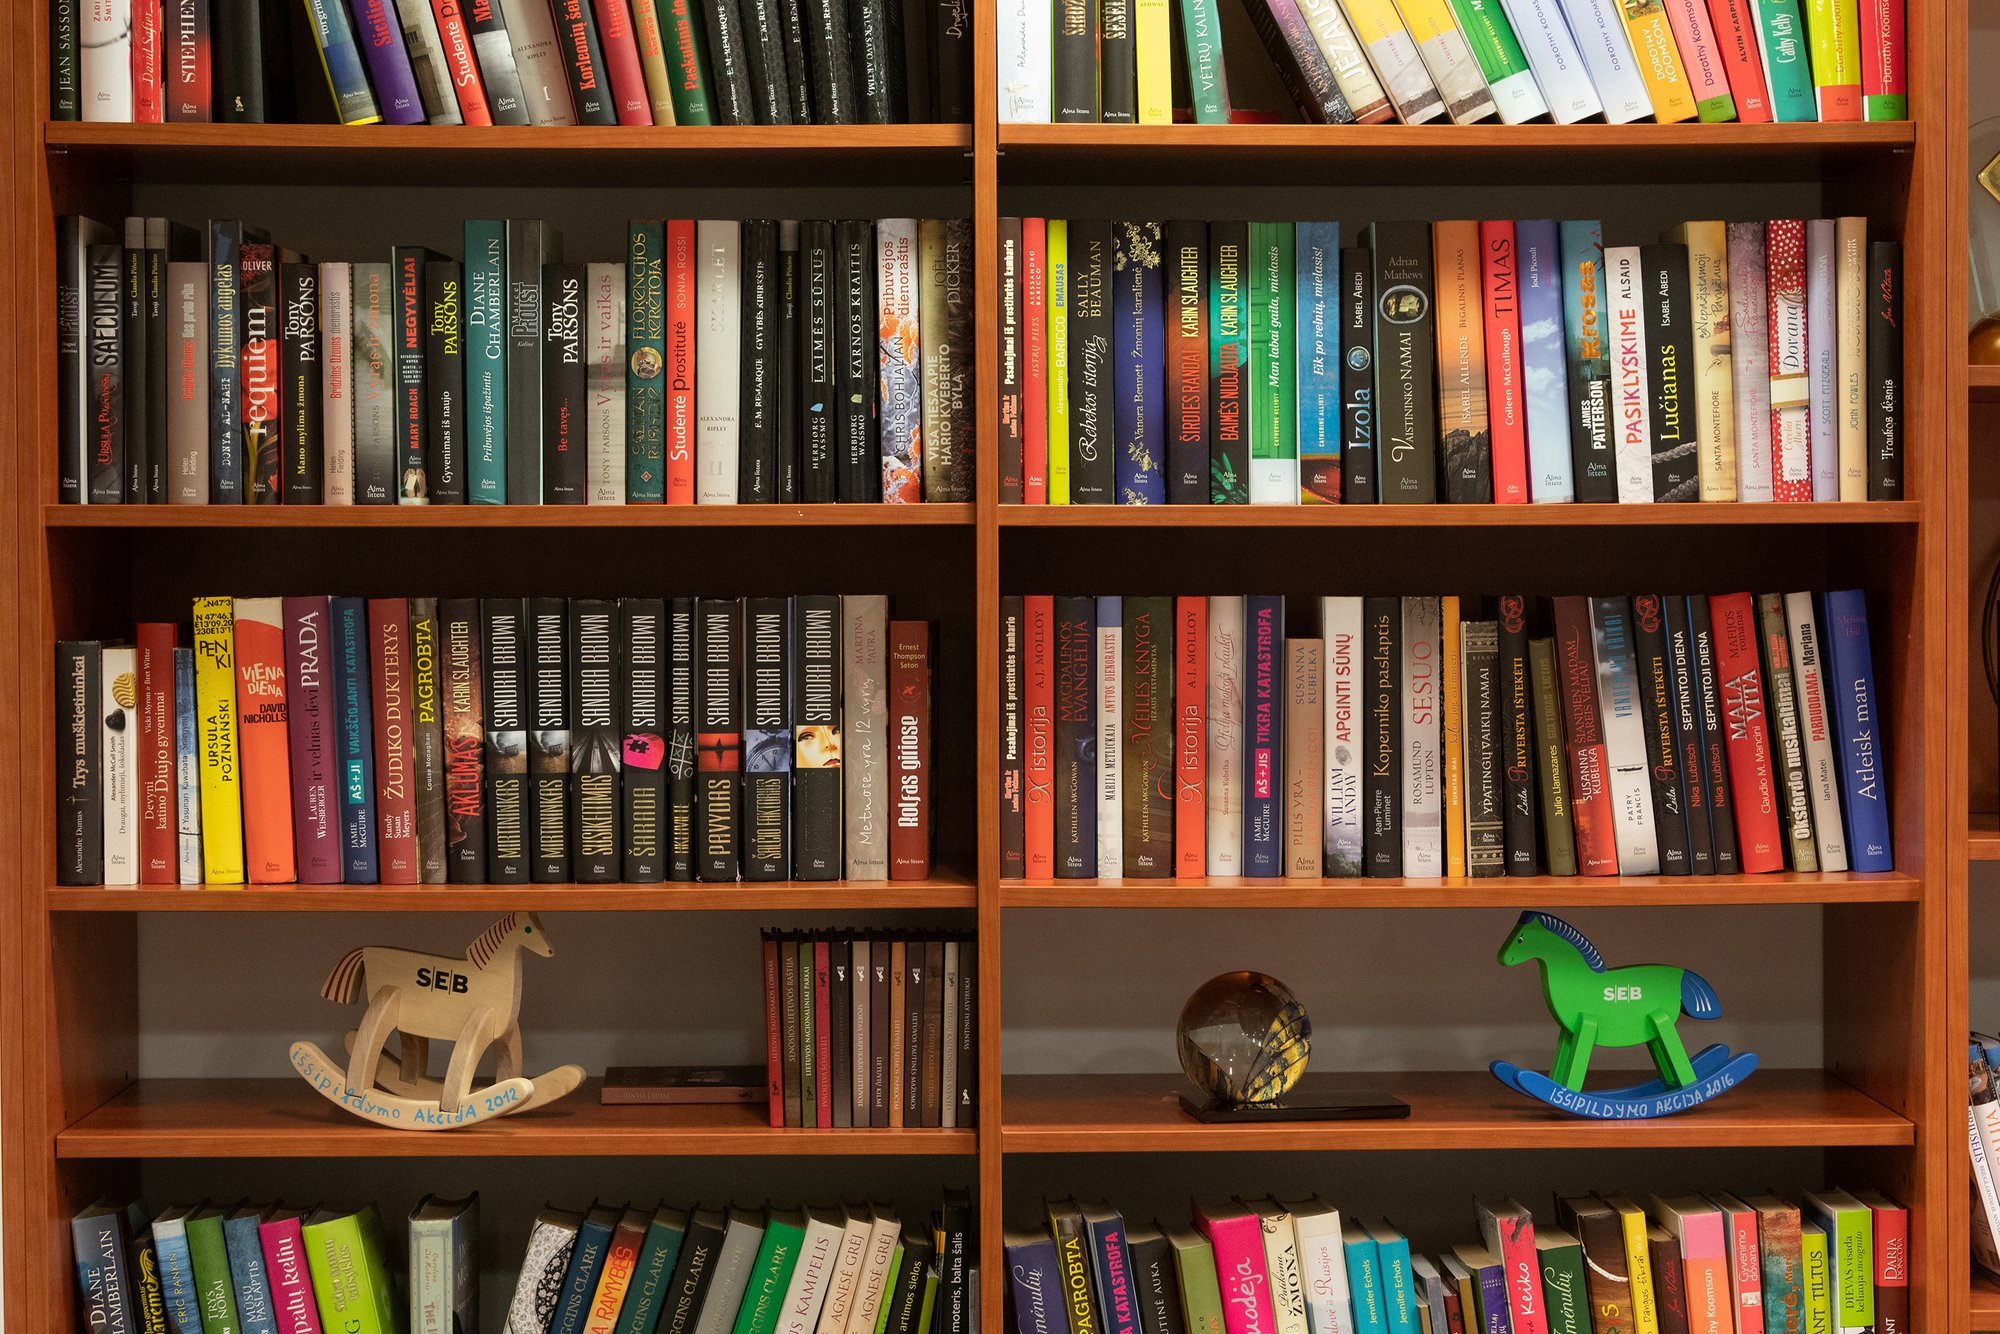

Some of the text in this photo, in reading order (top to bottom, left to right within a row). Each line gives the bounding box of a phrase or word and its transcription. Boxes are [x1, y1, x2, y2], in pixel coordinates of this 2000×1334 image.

[449, 20, 476, 87] Studentė
[517, 40, 552, 52] ALEXANDRA
[527, 51, 547, 60] RIPLEY
[571, 16, 595, 91] Korleonių
[717, 5, 730, 54] REMARQUE
[1545, 26, 1567, 71] DOROTHY
[1642, 28, 1664, 81] DOROTHY
[1652, 19, 1678, 83] KOOMSON
[1737, 35, 1747, 62] ALVIN
[1773, 13, 1797, 63] Cathy Kelly
[60, 67, 73, 91] JEAN
[1195, 41, 1212, 91] VĖTRŲ
[1694, 45, 1715, 86] Dorothy
[1883, 35, 1892, 83] Dorothy
[242, 261, 272, 271] OLIVER
[633, 233, 648, 340] FLORENCIJOS
[678, 236, 686, 308] SONIA ROSSI
[883, 241, 893, 317] Pribuvėjos
[897, 237, 909, 317] dienoraštis
[1056, 263, 1064, 307] EMAUSAS
[1090, 241, 1102, 317] BEAUMAN
[1384, 270, 1423, 280] Mathews
[1389, 257, 1418, 266] Adrian
[1492, 239, 1513, 318] TIMAS
[215, 263, 235, 369] Dykumos angelas
[285, 301, 299, 339] Tony
[300, 277, 314, 361] PARSONS
[406, 257, 416, 349] NEGYVĖLIAI
[431, 301, 446, 335] Tony
[445, 281, 457, 355] PARSONS
[470, 271, 485, 326] DIANE
[485, 238, 501, 360] CHAMBERLAIN
[548, 301, 565, 341] Tony
[563, 279, 579, 363] PARSONS
[812, 248, 824, 383] LAIMĖS SŪNUS
[851, 243, 862, 379] KARNOS KRAITIS
[1078, 271, 1089, 317] SALLY
[1182, 247, 1198, 337] KARIN SLAUGHTER
[1269, 246, 1279, 388] Man labai mielasis
[1620, 258, 1642, 444] PASIKLYSKIME ALSAID
[1787, 304, 1799, 368] Dovana
[244, 306, 275, 436] requiem
[671, 320, 690, 461] Studentė prostitutė
[1503, 328, 1514, 426] Colleen McCullough
[1659, 344, 1680, 440] Lučianas
[297, 375, 307, 475] Mano mylima žmona
[1133, 364, 1144, 440] Vanora Bennett
[1179, 393, 1201, 441] ŠIRDIES
[1347, 388, 1371, 450] Izola
[1582, 400, 1591, 429] JAMES
[1591, 380, 1606, 450] PATTERSON
[411, 420, 420, 449] MARY
[442, 431, 453, 483] Gyvenimas
[855, 615, 863, 665] MARTINA
[894, 653, 926, 661] Thompson
[1035, 611, 1044, 665] MOLLOY
[242, 662, 285, 681] VIENA
[248, 681, 283, 697] DIENA
[416, 619, 434, 723] PAGROBTA
[451, 621, 471, 714] KARIN SLAUGHTER
[492, 615, 518, 727] SANDRA BROWN
[1257, 608, 1272, 743] TIKRA KATASTROFA
[1333, 633, 1352, 742] APGINTI SŪNŲ
[1412, 641, 1432, 725] SESUO
[1480, 668, 1489, 708] NAMAI
[1674, 631, 1692, 731] SEPTINTOJI DIENA
[1738, 669, 1759, 722] VITA
[1802, 623, 1825, 741] PARDUODAMA: Mariana
[72, 656, 86, 757] muškietininkai
[244, 714, 286, 724] NICHOLLS
[260, 704, 286, 713] DAVID
[384, 623, 404, 799] ŽUDIKO DUKTERYS
[1726, 676, 1747, 740] MALA
[208, 716, 219, 767] URSULA
[1853, 678, 1877, 801] Atleisk man
[898, 716, 921, 827] Rolfas giriose
[1105, 771, 1115, 801] MARIJA
[1332, 768, 1343, 826] WILLIAM
[1345, 774, 1356, 826] LANDAY
[1482, 752, 1493, 814] YPATINGŲ
[1551, 745, 1563, 816] Julio Llamazares
[1579, 749, 1593, 801] SUSANNA
[1589, 748, 1603, 795] KUBELKA
[308, 786, 317, 820] LAUREN
[317, 785, 326, 839] WEISBERGER
[496, 779, 521, 859] MIRTININKAS
[708, 779, 731, 855] PAVYDAS
[1254, 816, 1263, 841] JAMIE
[1374, 789, 1382, 836] Jean-Pierre
[1384, 795, 1392, 830] Luminet
[416, 967, 468, 994] SEB
[1603, 985, 1642, 1003] SEB
[485, 1088, 518, 1112] 2012
[1550, 1074, 1734, 1118] IŠSIPILDYMO AKCIJA 2016
[795, 1236, 830, 1318] KAMPELIS
[831, 1234, 865, 1324] AGNESĖ GRĖJ
[908, 1261, 921, 1291] sielos
[950, 1232, 964, 1332] moteris, balta šalis
[1105, 1231, 1132, 1327] KATASTROFA
[1738, 1229, 1749, 1283] Gyvenimo
[1750, 1244, 1759, 1282] dovana
[1813, 1250, 1823, 1300] TILTUS
[1845, 1235, 1855, 1309] DIEVAS visada
[89, 1267, 107, 1326] DIANE
[1364, 1259, 1379, 1324] Jennifer Echols
[1516, 1262, 1536, 1316] Keiko
[1635, 1256, 1653, 1323] Dangus tikrai
[1705, 1268, 1716, 1320] Koomson
